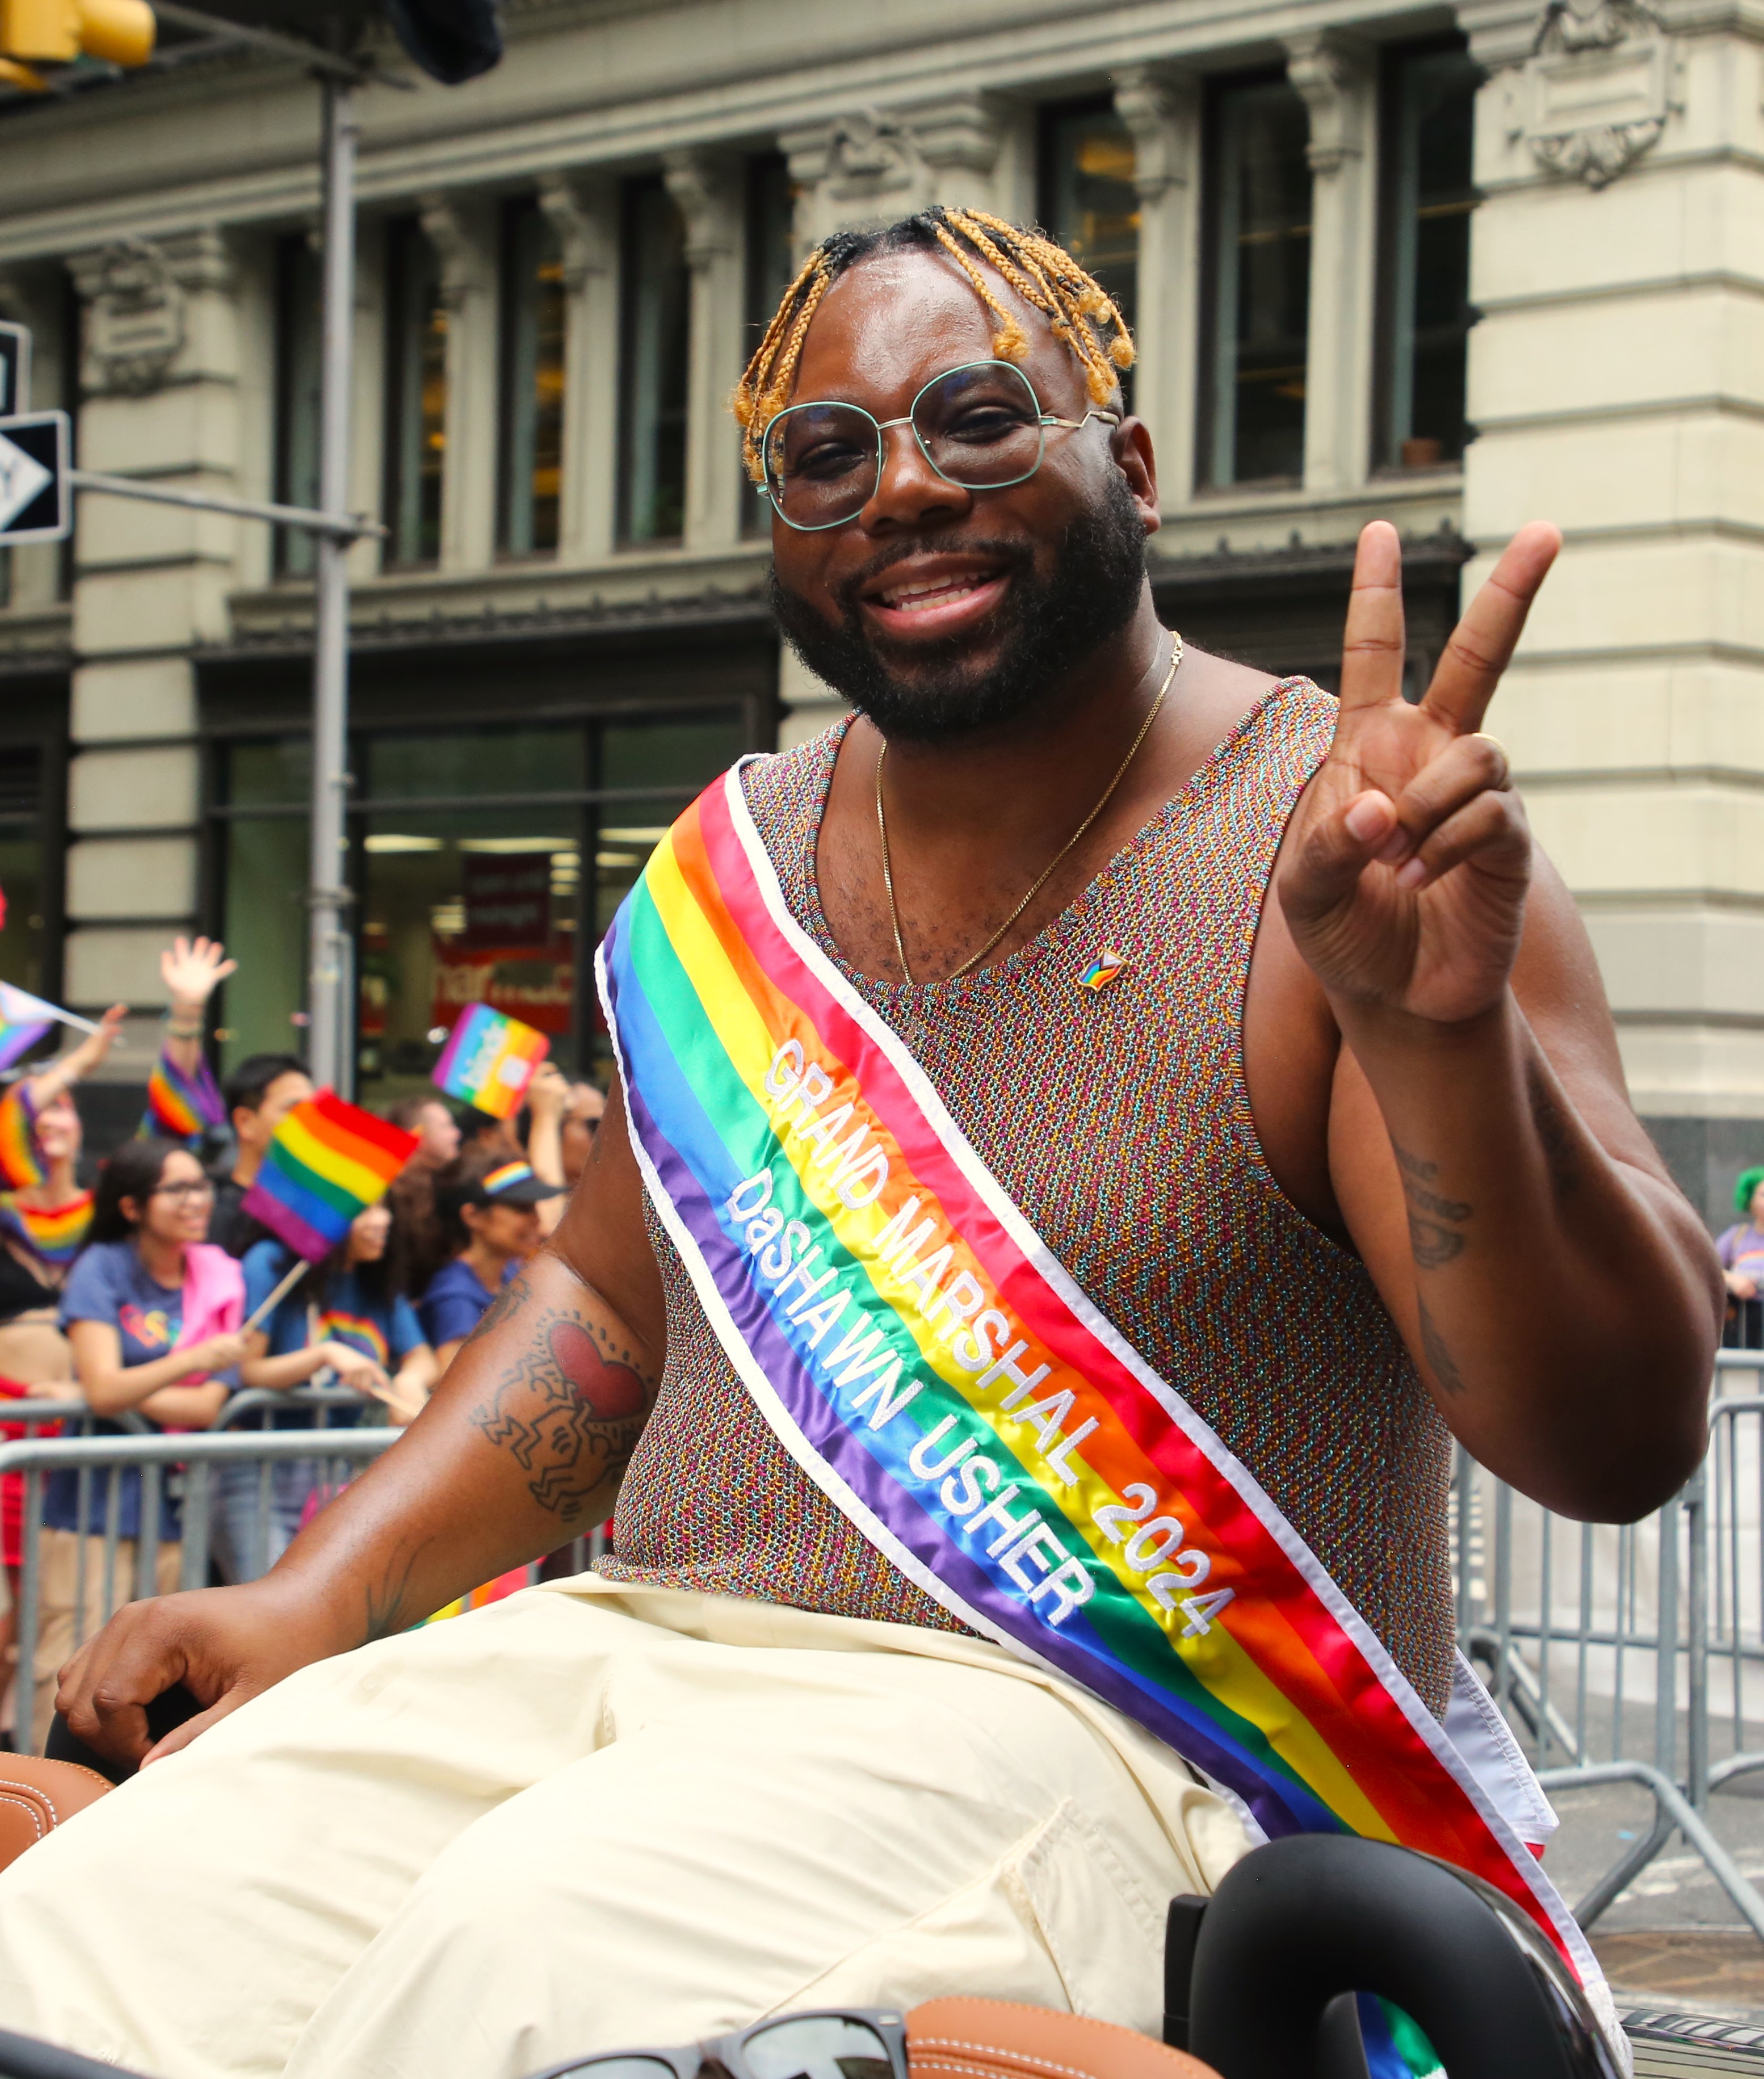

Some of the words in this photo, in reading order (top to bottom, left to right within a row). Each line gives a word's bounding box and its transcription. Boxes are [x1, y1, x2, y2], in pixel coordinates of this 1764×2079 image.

[726, 1167, 924, 1432] DaSHAWN
[908, 1413, 1096, 1627] USHER
[764, 1038, 889, 1211] GRAND
[871, 1195, 1099, 1488] MARSHAL
[1092, 1482, 1236, 1638] 2024
